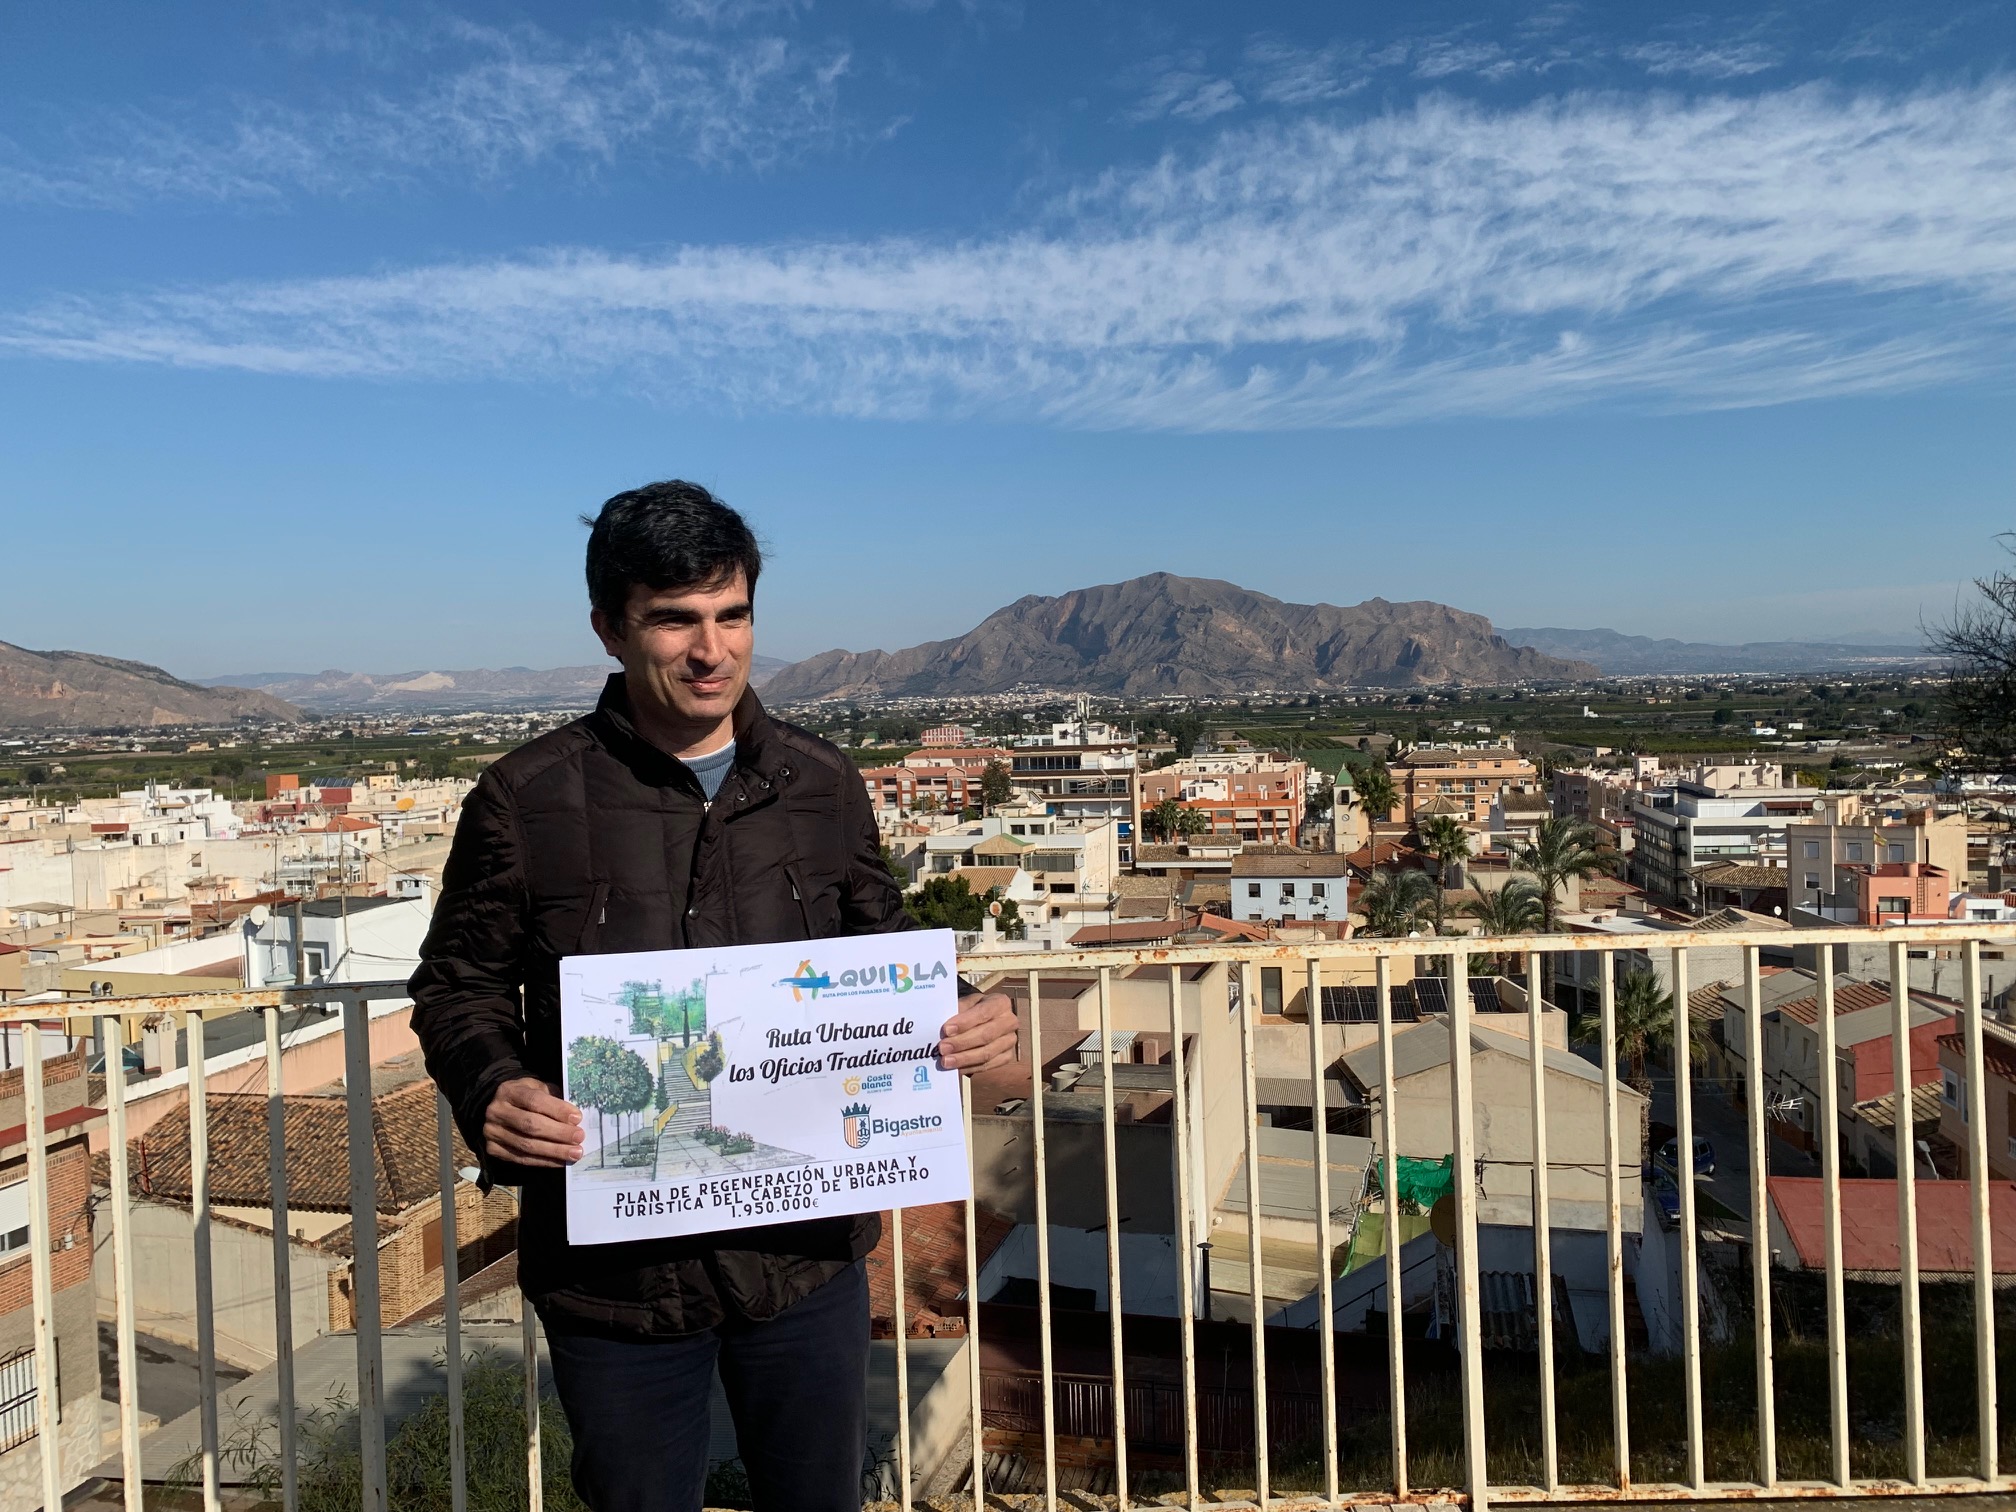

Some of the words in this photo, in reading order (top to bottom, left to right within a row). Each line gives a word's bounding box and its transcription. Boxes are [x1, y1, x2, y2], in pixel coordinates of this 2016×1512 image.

[772, 959, 948, 1002] ALQUIBLA
[765, 1027, 812, 1048] Ruta
[815, 1022, 888, 1043] Urbana
[892, 1017, 914, 1036] de
[729, 1064, 755, 1083] los
[759, 1056, 823, 1084] Oficios
[827, 1042, 940, 1072] Tradicionale
[861, 1080, 892, 1090] Blanca
[867, 1073, 892, 1083] Costa
[872, 1115, 942, 1137] Bigastro
[900, 1126, 943, 1137] Ayuntamiento
[613, 1197, 704, 1218] TURISTICA
[713, 1191, 743, 1207] DEL
[751, 1182, 813, 1201] CABEZO
[821, 1179, 841, 1193] DE
[850, 1167, 929, 1190] BIGASTRO
[616, 1189, 660, 1205] PLAN
[670, 1185, 690, 1200] DE
[699, 1165, 824, 1196] REGENERACIÓN
[833, 1158, 900, 1178] URBANA
[907, 1155, 917, 1168] Y
[731, 1196, 819, 1218] 1.950.000€
